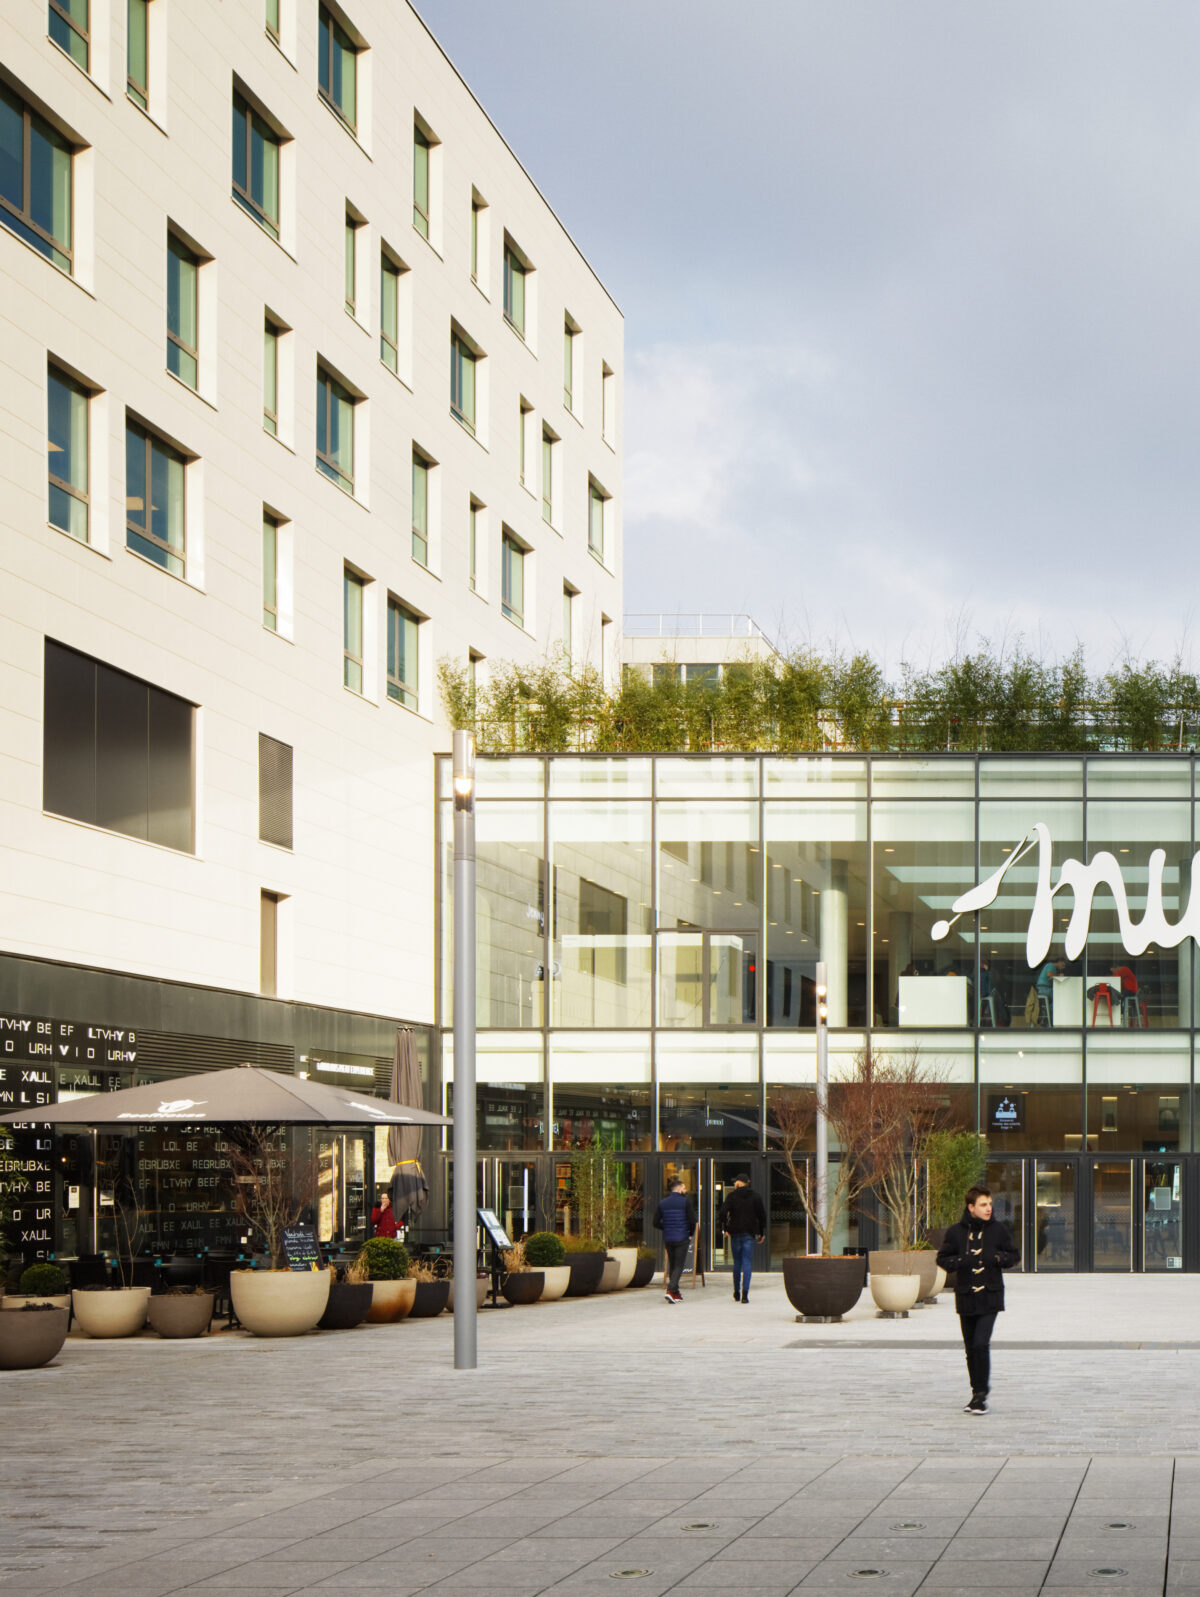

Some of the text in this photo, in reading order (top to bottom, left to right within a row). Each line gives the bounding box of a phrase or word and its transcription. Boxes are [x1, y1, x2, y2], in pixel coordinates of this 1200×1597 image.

[88, 1027, 124, 1042] LTVHY
[107, 1049, 137, 1062] URHV
[21, 1070, 52, 1083] XAUL
